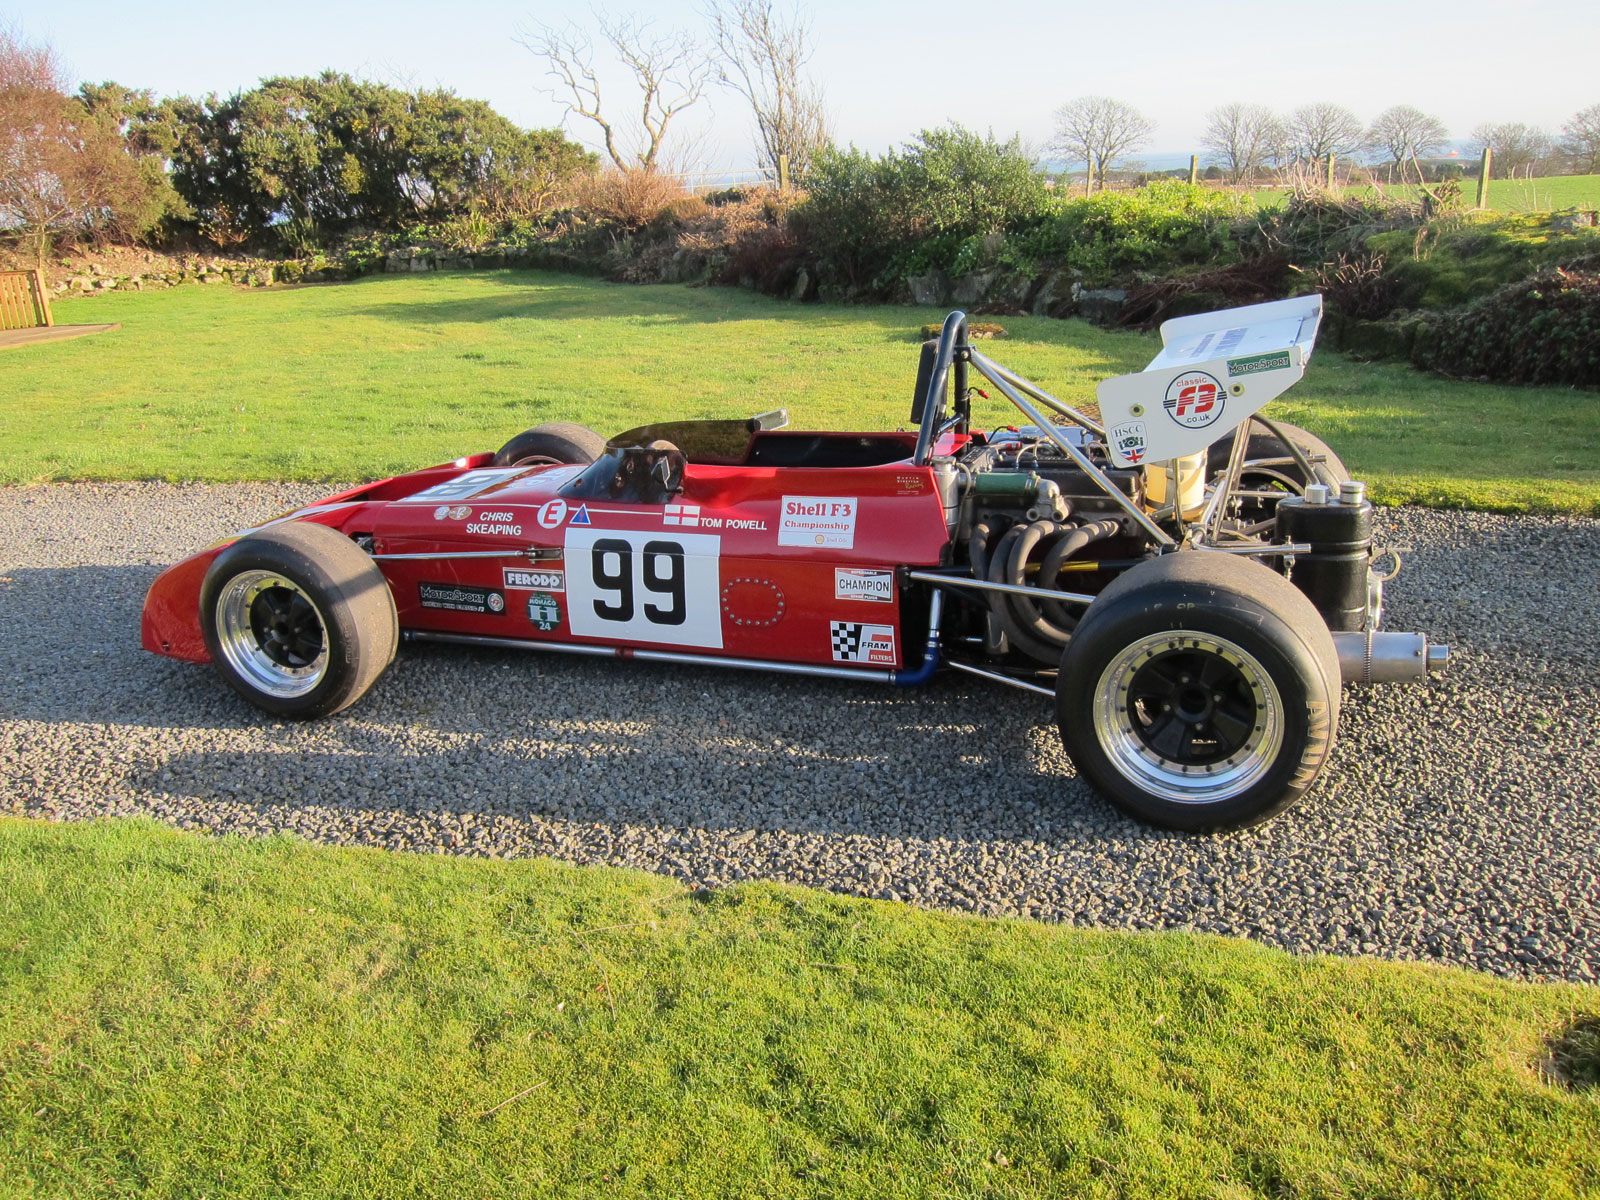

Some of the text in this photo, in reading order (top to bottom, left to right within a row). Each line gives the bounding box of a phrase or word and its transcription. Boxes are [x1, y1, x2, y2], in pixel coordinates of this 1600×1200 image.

[1176, 376, 1207, 387] classic
[1176, 384, 1216, 416] F3
[1185, 414, 1210, 424] .co.uk
[1114, 425, 1142, 437] HSCC
[543, 501, 563, 524] E
[786, 502, 852, 517] Shell F3
[479, 511, 514, 522] CHRIS
[466, 523, 522, 536] SKEAPING
[700, 517, 768, 531] TOM POWELL
[784, 520, 850, 531] Championship
[507, 572, 560, 587] FERODO
[591, 538, 687, 625] 99
[839, 579, 890, 592] CHAMPION
[539, 621, 551, 631] 24
[861, 641, 889, 650] FRAM
[870, 654, 893, 662] FILTERS
